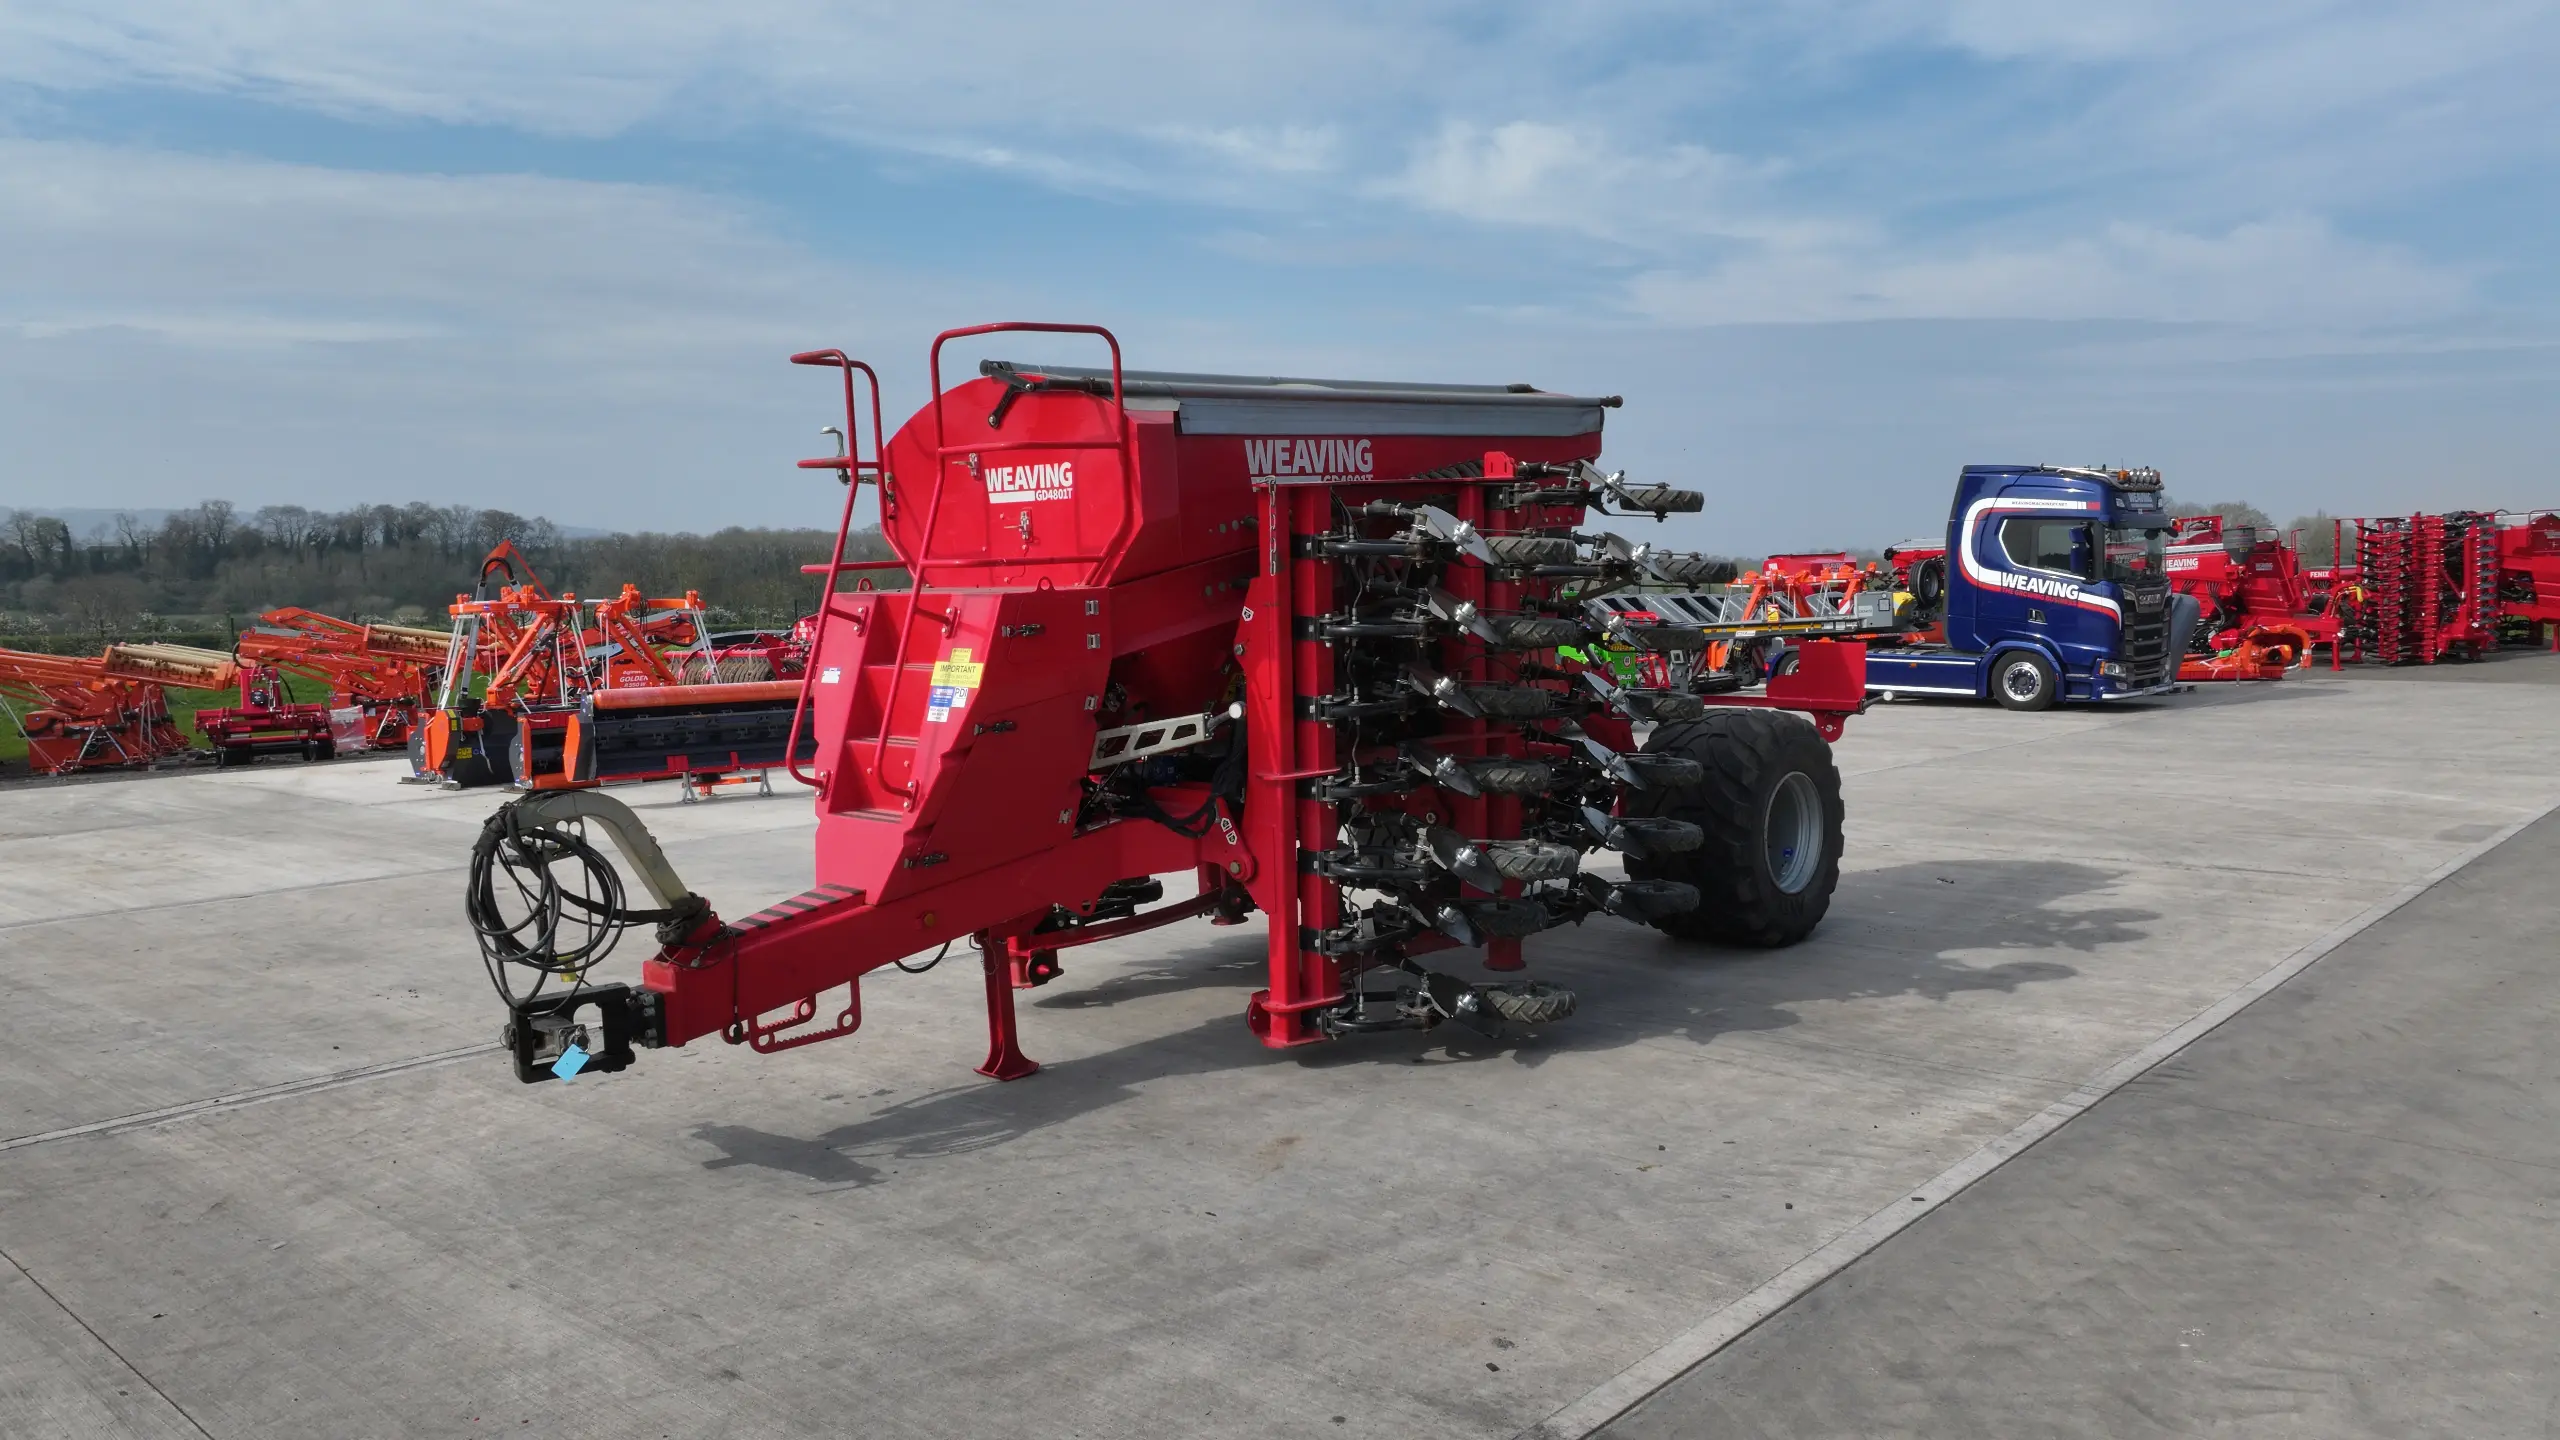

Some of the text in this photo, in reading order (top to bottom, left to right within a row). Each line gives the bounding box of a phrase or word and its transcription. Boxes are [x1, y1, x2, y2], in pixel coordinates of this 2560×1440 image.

[1244, 438, 1374, 475] WEAVING
[984, 461, 1073, 492] WEAVING
[1035, 488, 1073, 501] GD4801T
[2002, 571, 2080, 600] WEAVING
[940, 664, 977, 673] IMPORTANT
[955, 687, 968, 698] PDI
